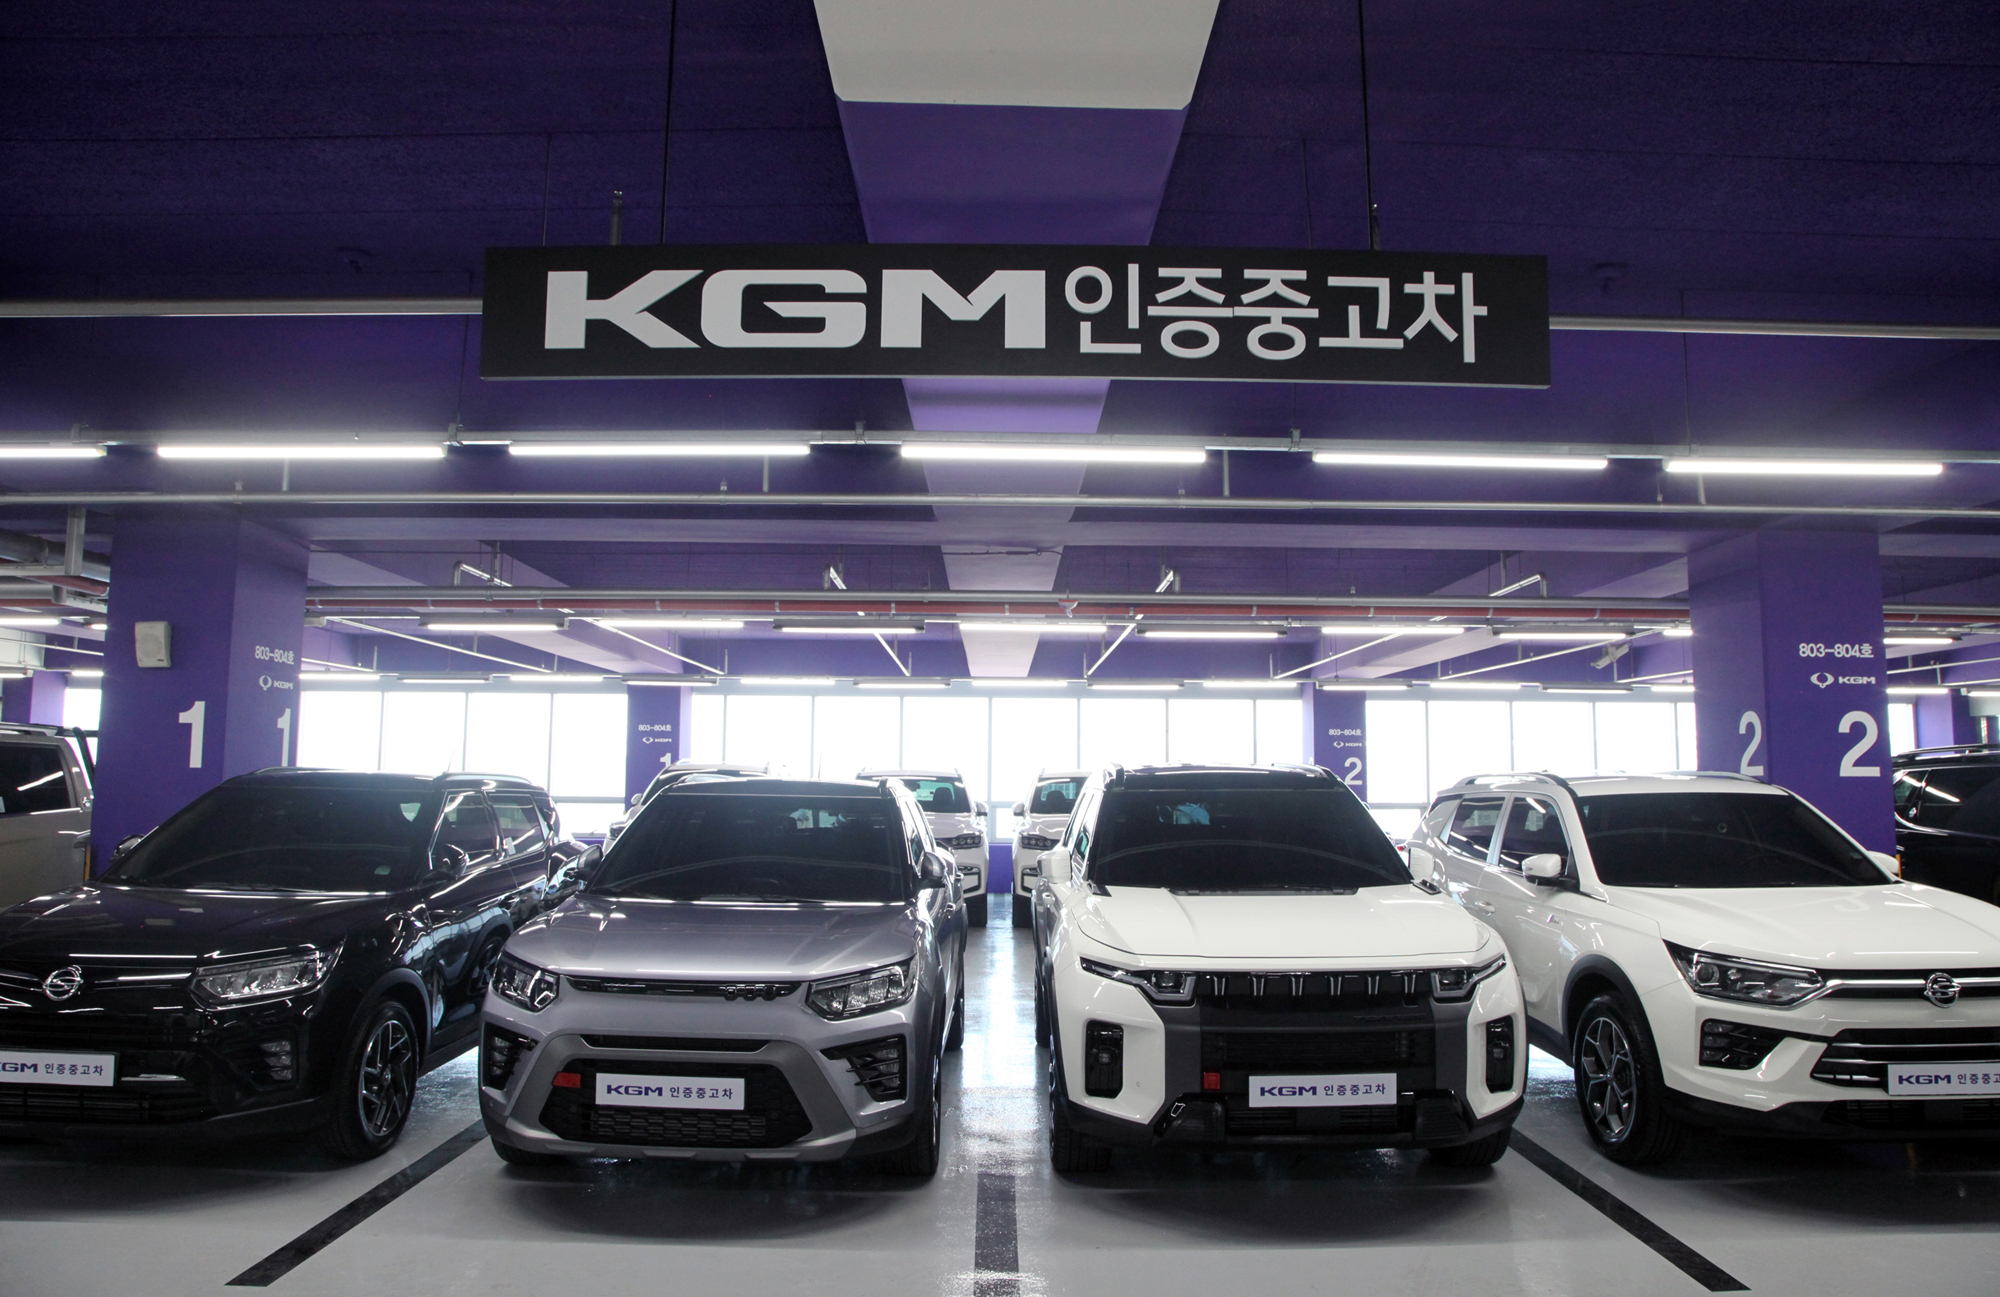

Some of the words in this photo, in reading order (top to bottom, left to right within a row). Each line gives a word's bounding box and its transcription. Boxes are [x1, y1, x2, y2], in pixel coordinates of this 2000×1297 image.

[544, 269, 1046, 349] KGM
[1064, 263, 1488, 364] 인증중고차
[254, 645, 295, 665] 803-804호
[1799, 643, 1874, 658] 803-804호
[273, 680, 293, 689] KGM
[1838, 676, 1876, 684] KGM
[178, 701, 205, 768] 1
[277, 708, 291, 767] 1
[1738, 710, 1764, 776] 2
[1838, 710, 1881, 777] 2
[1344, 757, 1363, 785] 2
[0, 1062, 38, 1073] GM
[44, 1063, 103, 1076] 인증중고차
[1898, 1074, 1951, 1085] KGM
[606, 1084, 663, 1097] KGM
[669, 1086, 733, 1099] 인증중고차
[1260, 1086, 1317, 1096] KGM
[1324, 1083, 1386, 1096] 인증중고차
